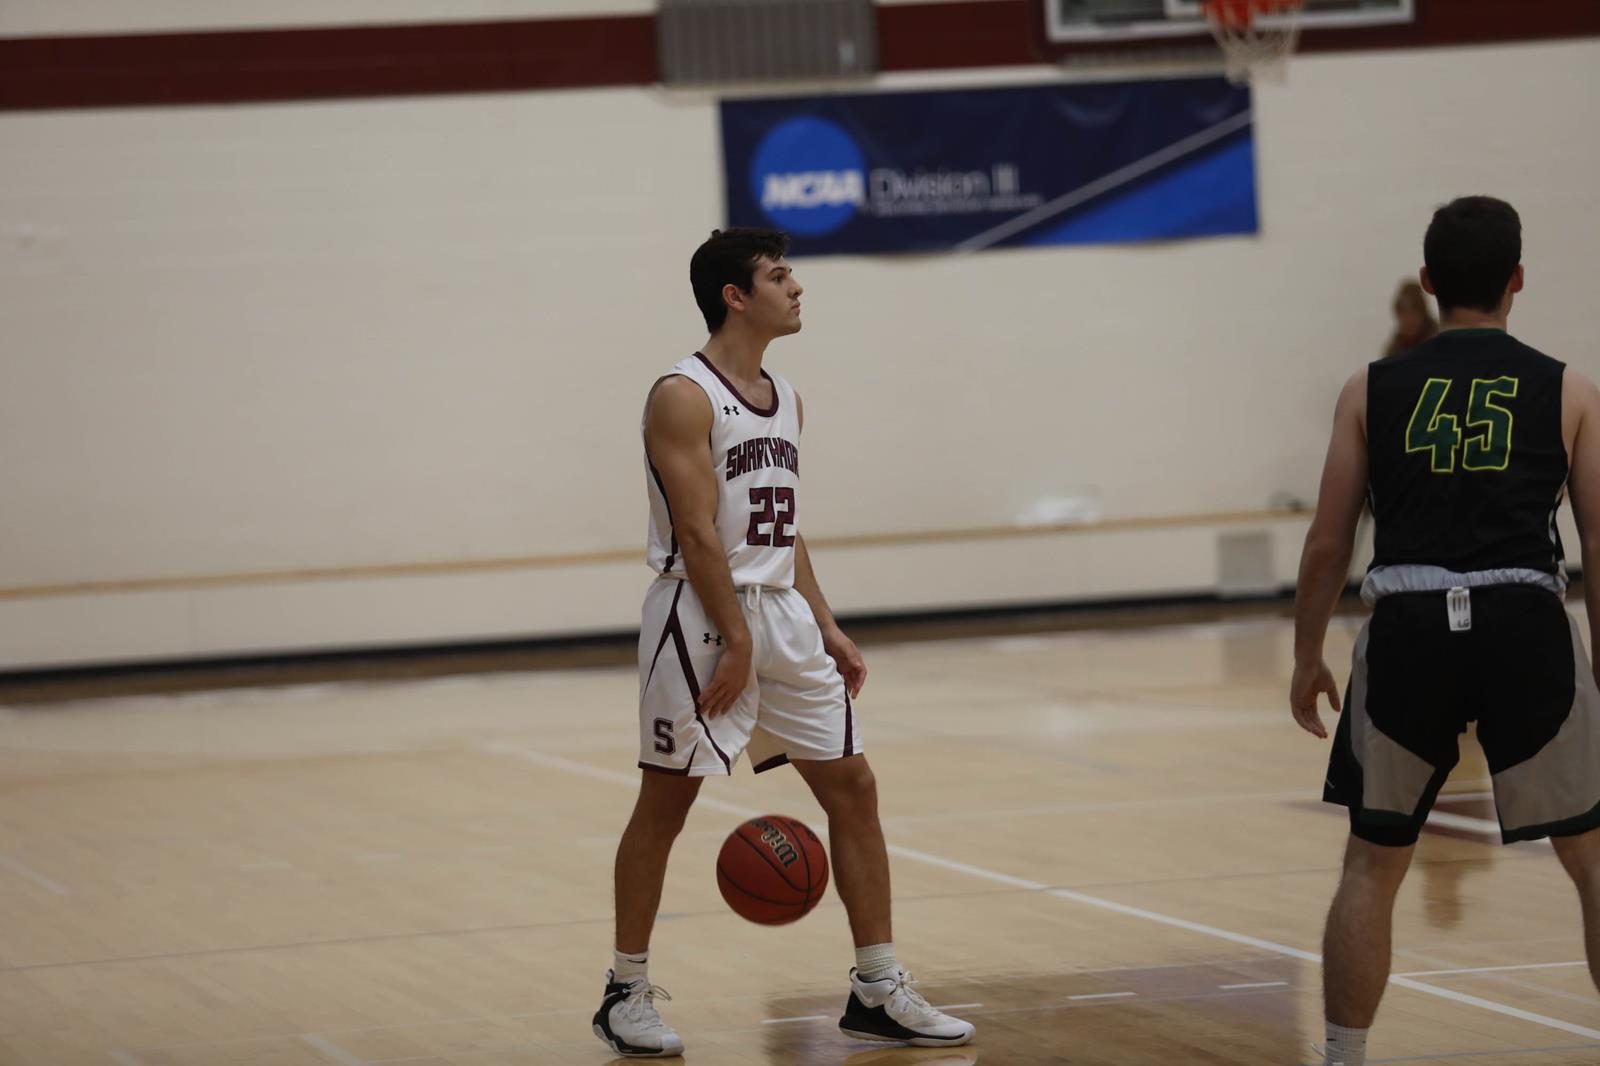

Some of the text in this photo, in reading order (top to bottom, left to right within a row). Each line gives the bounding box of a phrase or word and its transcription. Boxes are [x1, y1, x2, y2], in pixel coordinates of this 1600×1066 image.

[762, 169, 866, 210] NCAA
[870, 168, 991, 199] Division
[1405, 376, 1518, 473] 45
[746, 487, 795, 548] 22
[653, 717, 676, 756] S
